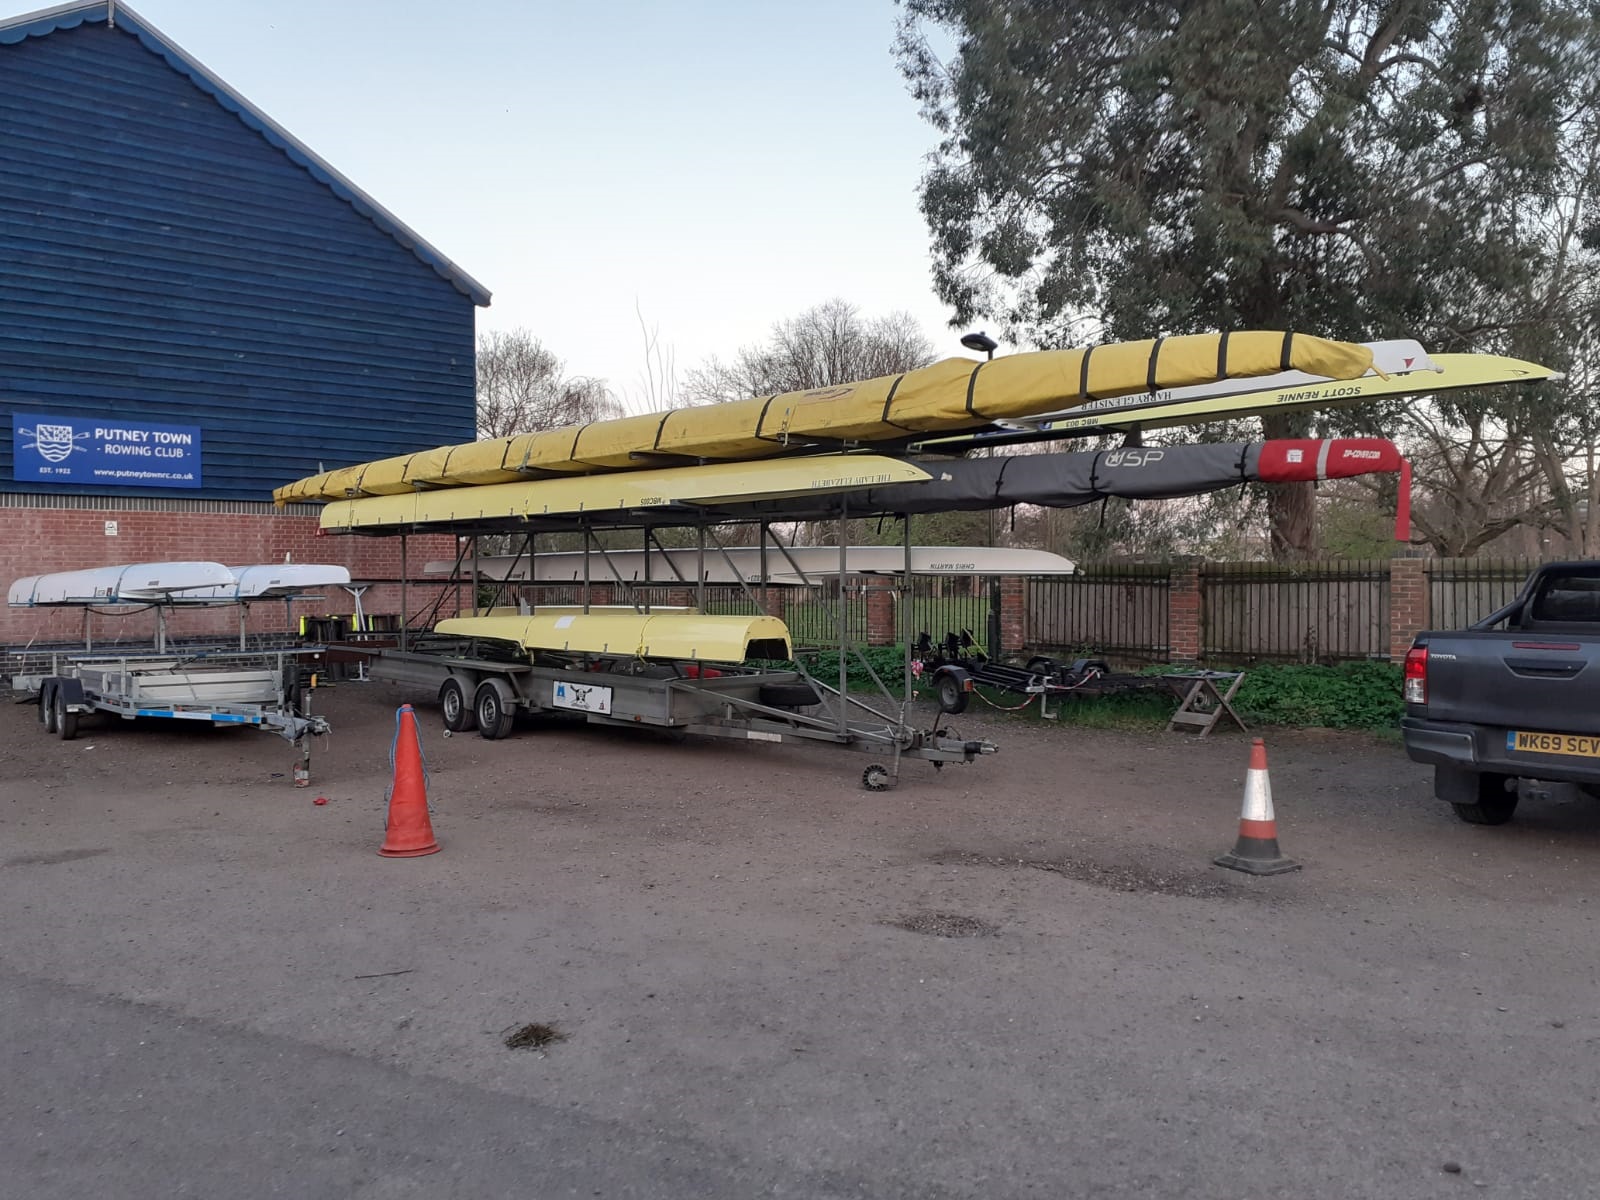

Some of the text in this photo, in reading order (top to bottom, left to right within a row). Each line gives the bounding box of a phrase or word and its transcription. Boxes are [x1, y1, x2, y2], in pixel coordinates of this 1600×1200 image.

[1277, 386, 1361, 402] SCOTT RENNIE
[95, 428, 192, 445] PUTNEY TOWN
[105, 444, 184, 458] ROWING CLUB
[94, 469, 194, 480] www.putneytownrc.co.uk
[1519, 733, 1600, 754] WK69 SCV
